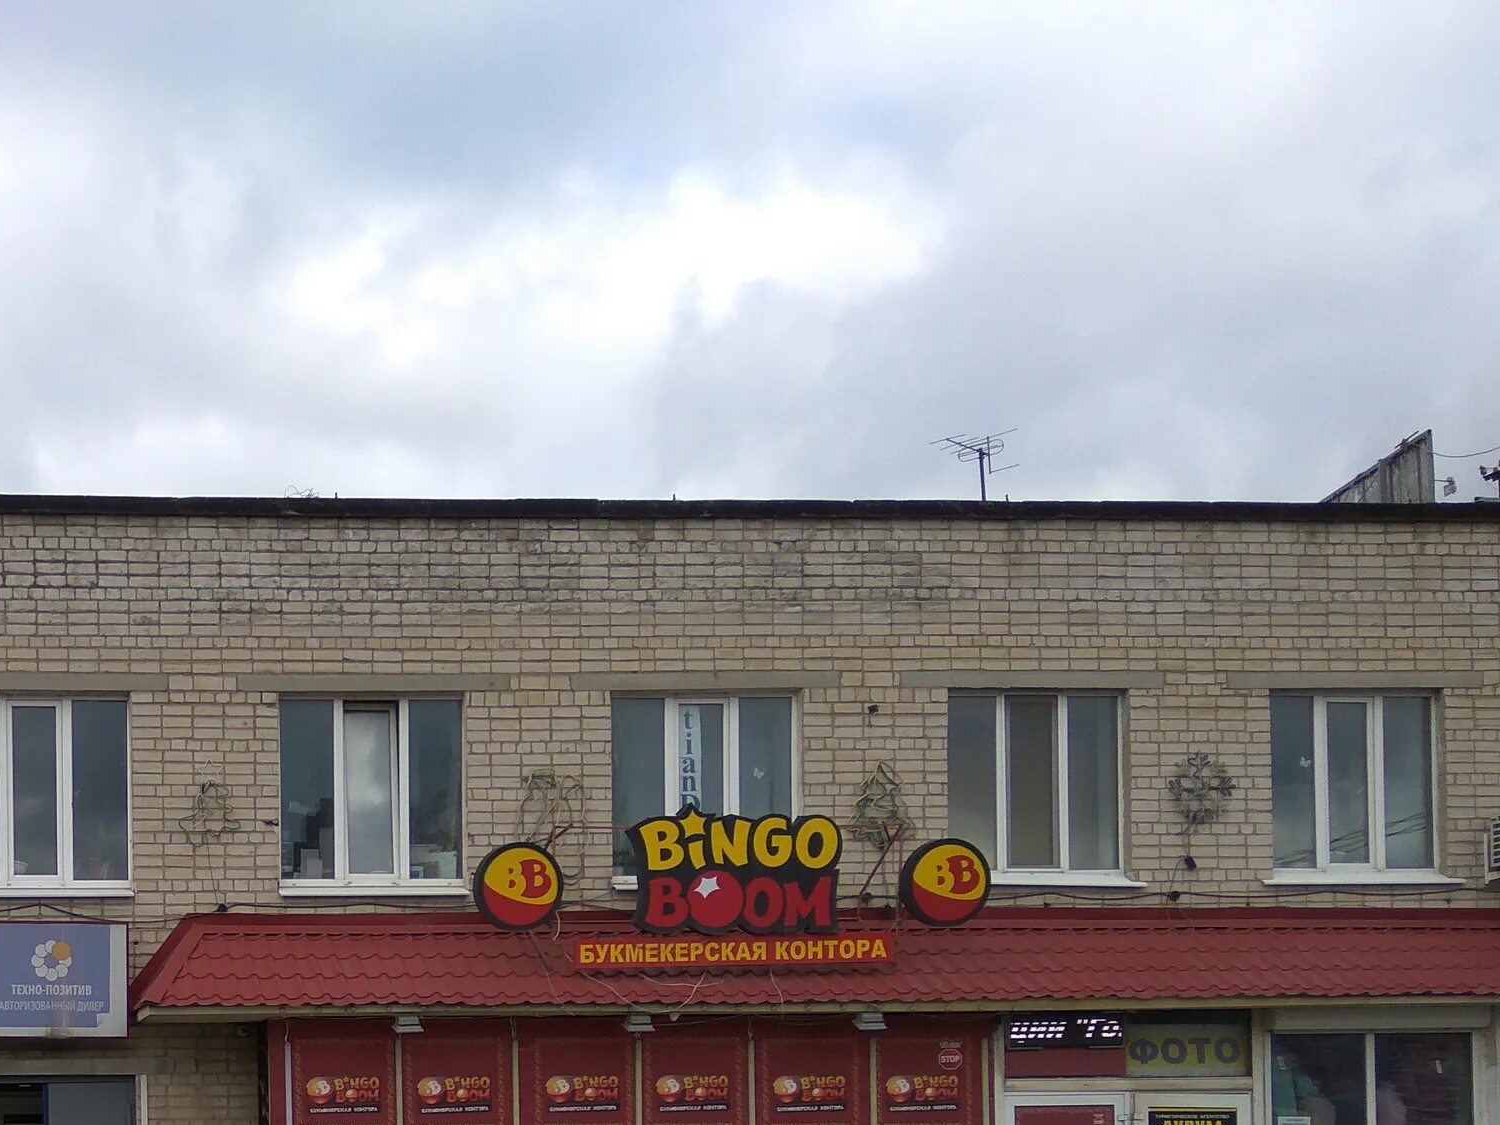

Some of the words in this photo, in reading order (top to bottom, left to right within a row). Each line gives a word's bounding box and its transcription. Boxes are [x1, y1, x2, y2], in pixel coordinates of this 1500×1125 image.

[644, 870, 832, 929] BOOM
[579, 941, 767, 964] БУКМЕКЕРСКАЯ
[775, 939, 887, 961] КОНТОРА
[11, 984, 92, 996] ТЕХНО-ПОЗИТИВ
[0, 1000, 76, 1011] АВТОРИЗОВАННЫЙ
[76, 1001, 104, 1012] ДИЛЕР
[941, 1055, 961, 1063] STOP
[1129, 1037, 1241, 1065] ФОТО
